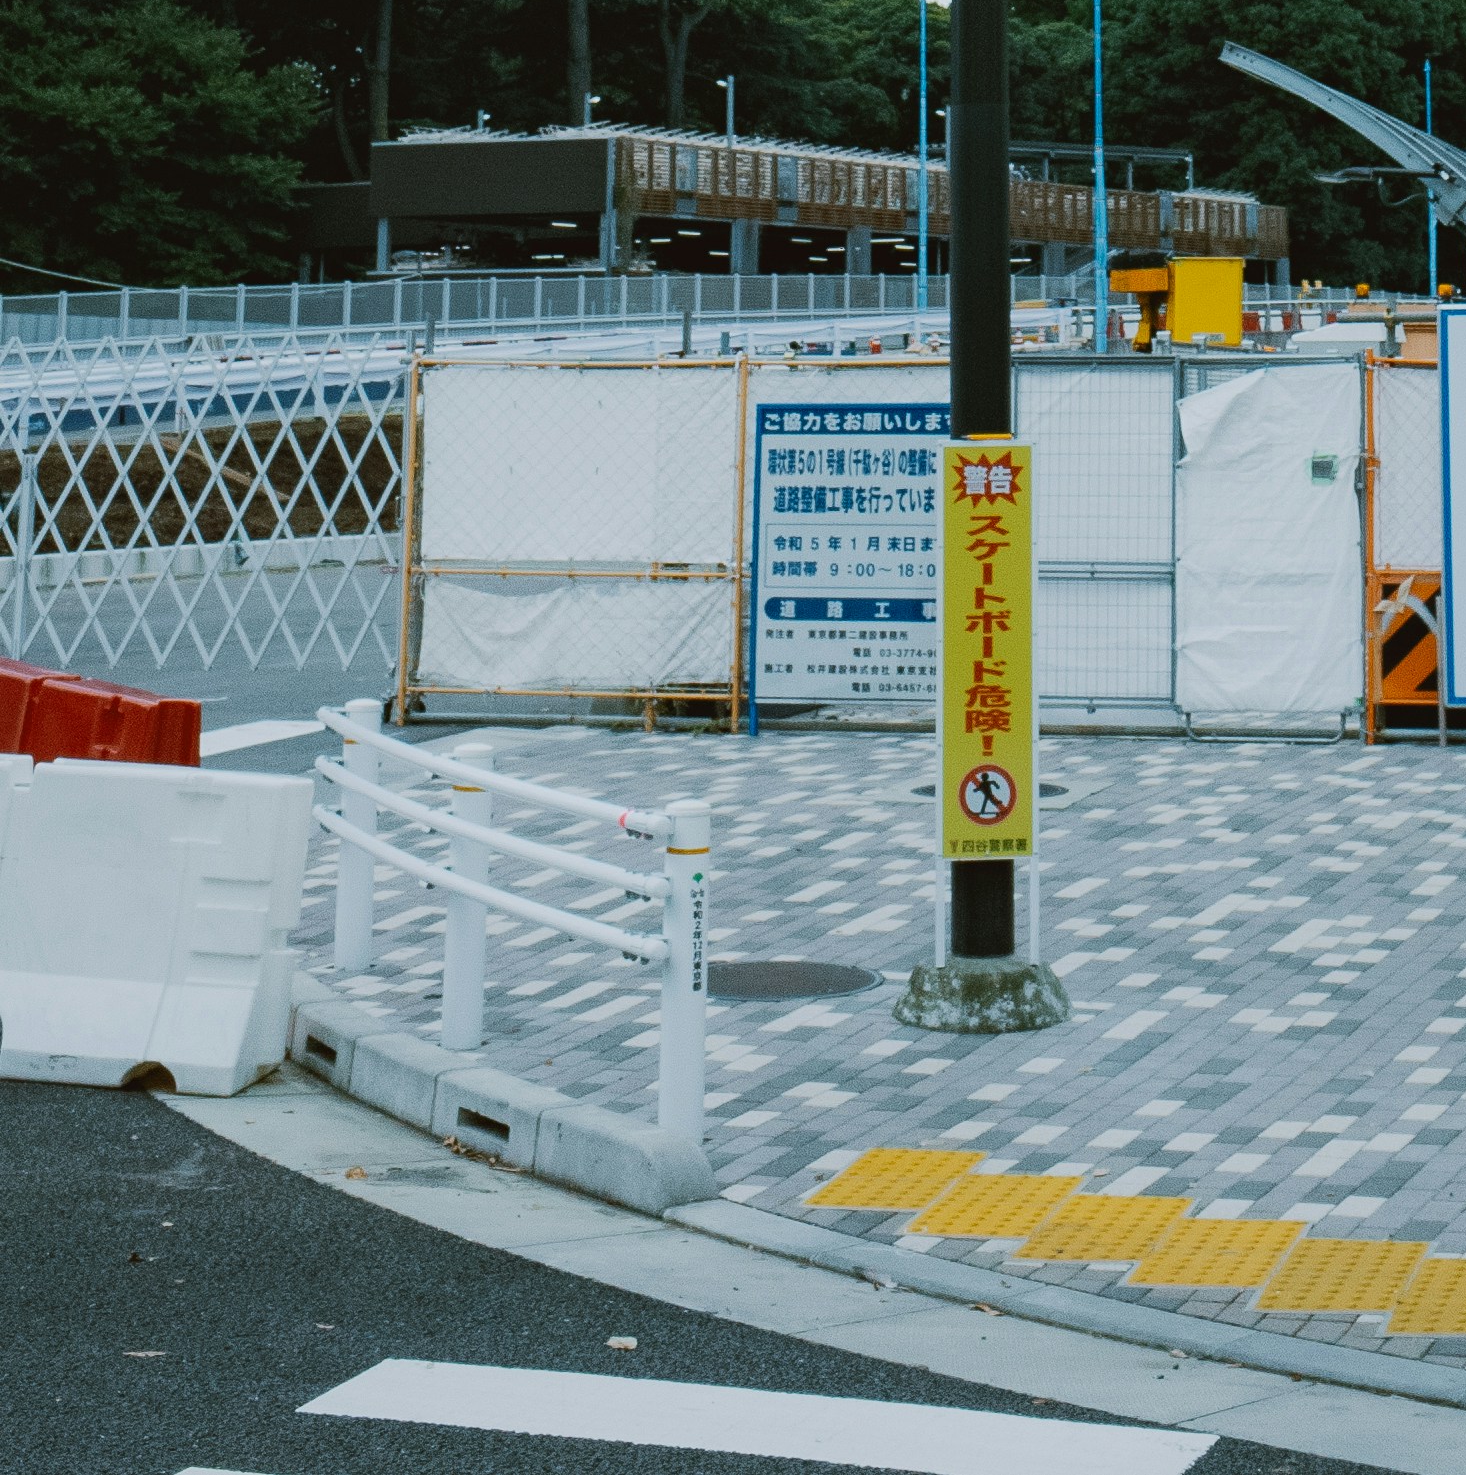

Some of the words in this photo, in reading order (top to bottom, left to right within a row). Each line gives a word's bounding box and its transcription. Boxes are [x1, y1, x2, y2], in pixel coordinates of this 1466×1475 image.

[764, 412, 950, 432] ご協力をお願いしま
[963, 463, 1014, 495] 警告
[773, 486, 935, 513] 道路整備工事を行っていま
[771, 561, 818, 577] 時間帯
